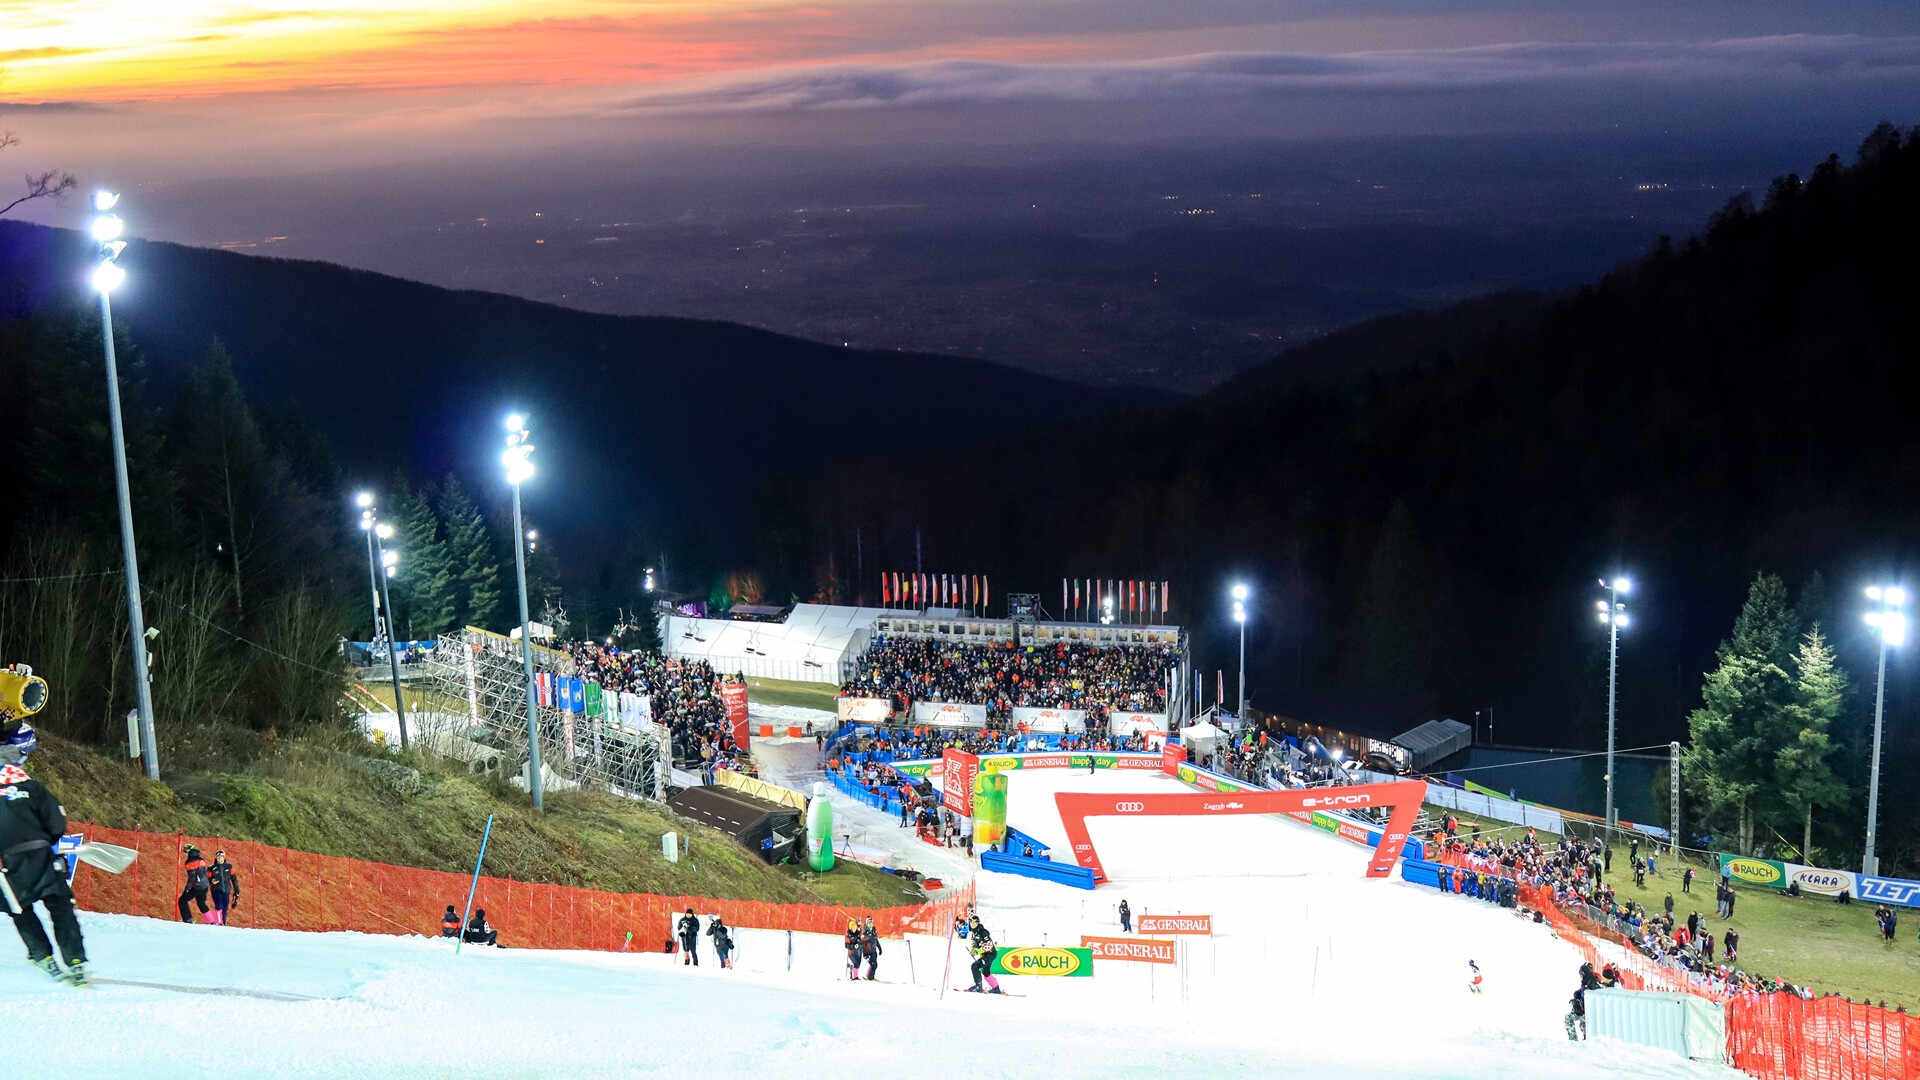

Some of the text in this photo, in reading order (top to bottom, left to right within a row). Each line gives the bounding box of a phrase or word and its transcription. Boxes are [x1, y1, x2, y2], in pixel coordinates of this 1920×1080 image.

[1033, 758, 1069, 766] GENERALI
[1071, 757, 1111, 767] happ day
[912, 766, 925, 775] day
[1302, 794, 1370, 807] e-tron
[1312, 813, 1336, 831] happy day
[1740, 864, 1773, 878] RAUCH
[1800, 872, 1838, 887] KLARA
[1156, 919, 1209, 931] GENERALI
[1104, 945, 1172, 960] GENERALI
[1022, 955, 1069, 969] RAUCH
